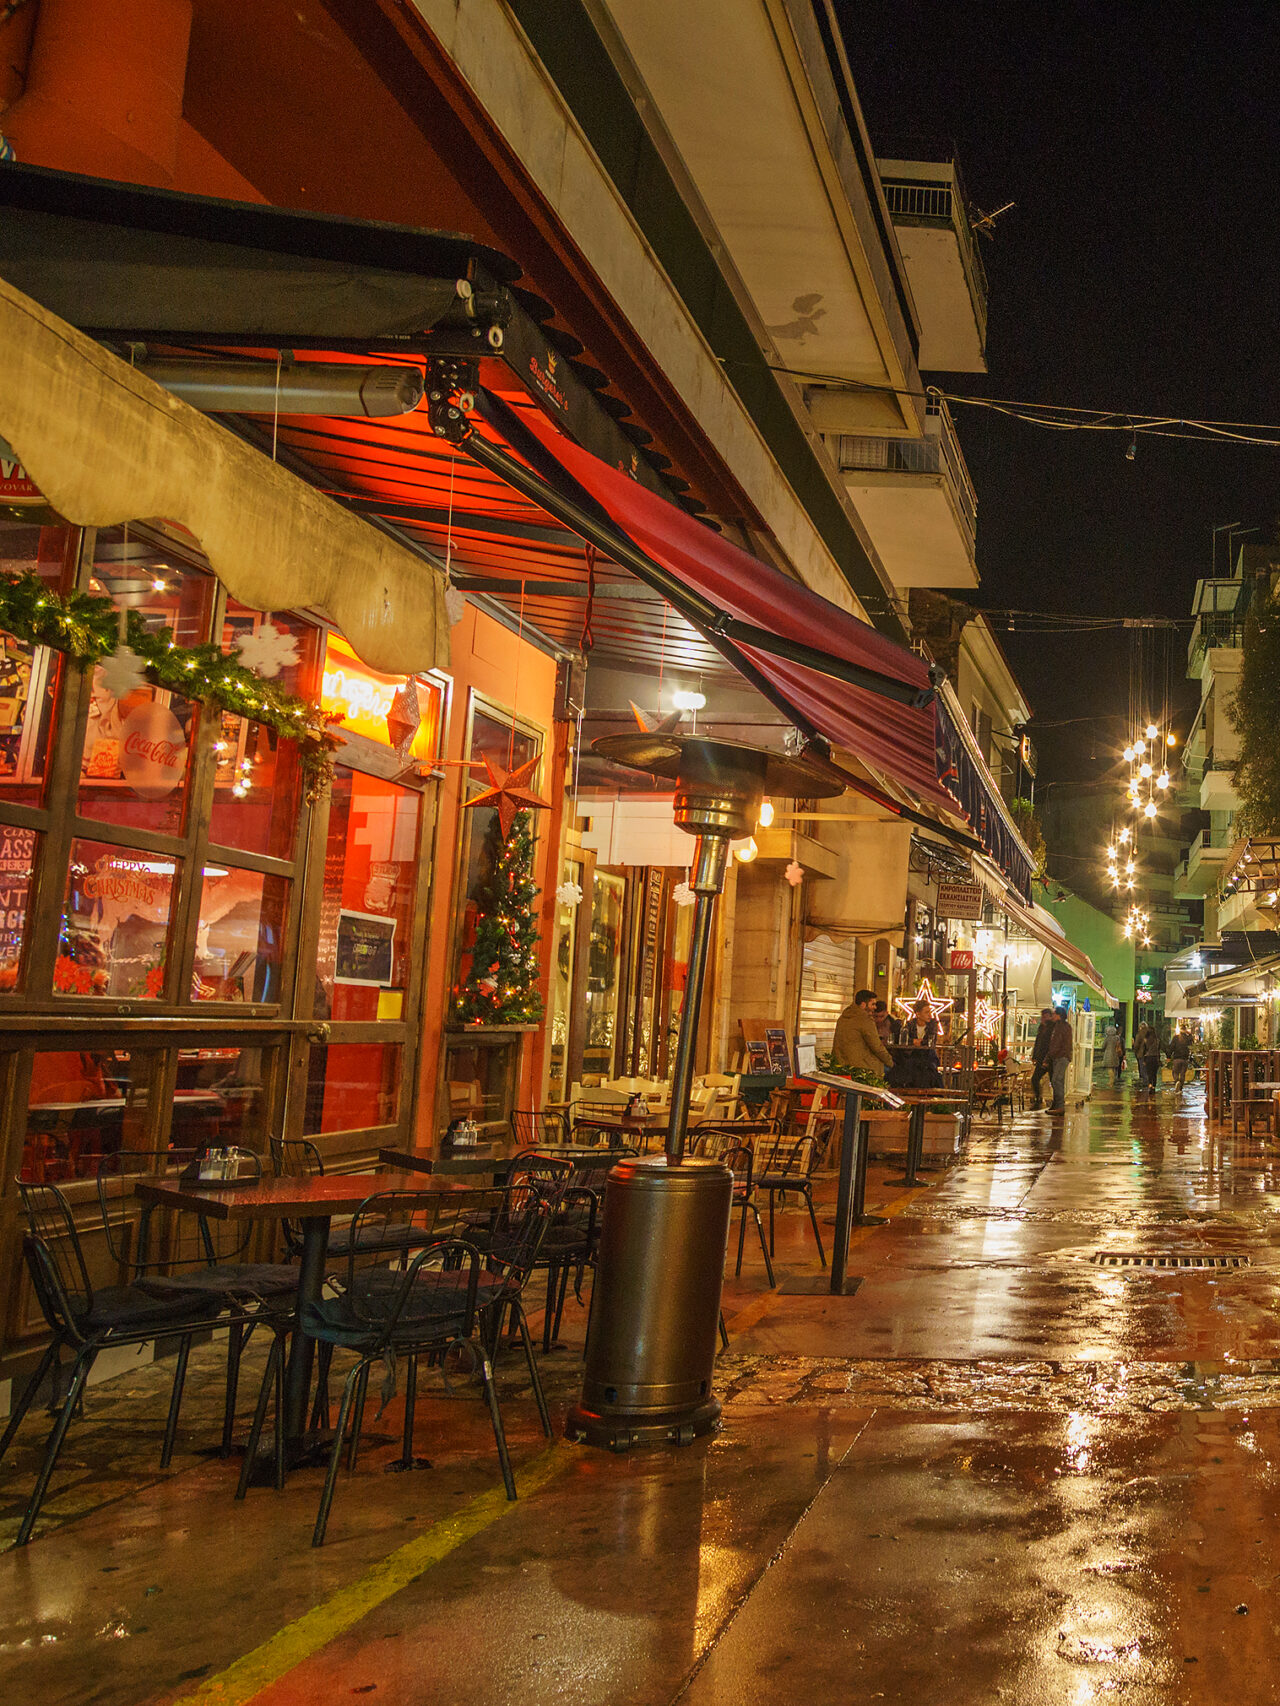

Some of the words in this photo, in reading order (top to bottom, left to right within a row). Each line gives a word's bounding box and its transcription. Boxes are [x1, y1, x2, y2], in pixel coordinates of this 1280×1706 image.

[124, 731, 179, 768] Coca-Cola
[83, 875, 154, 905] CHRISTMAS
[953, 953, 971, 969] illy
